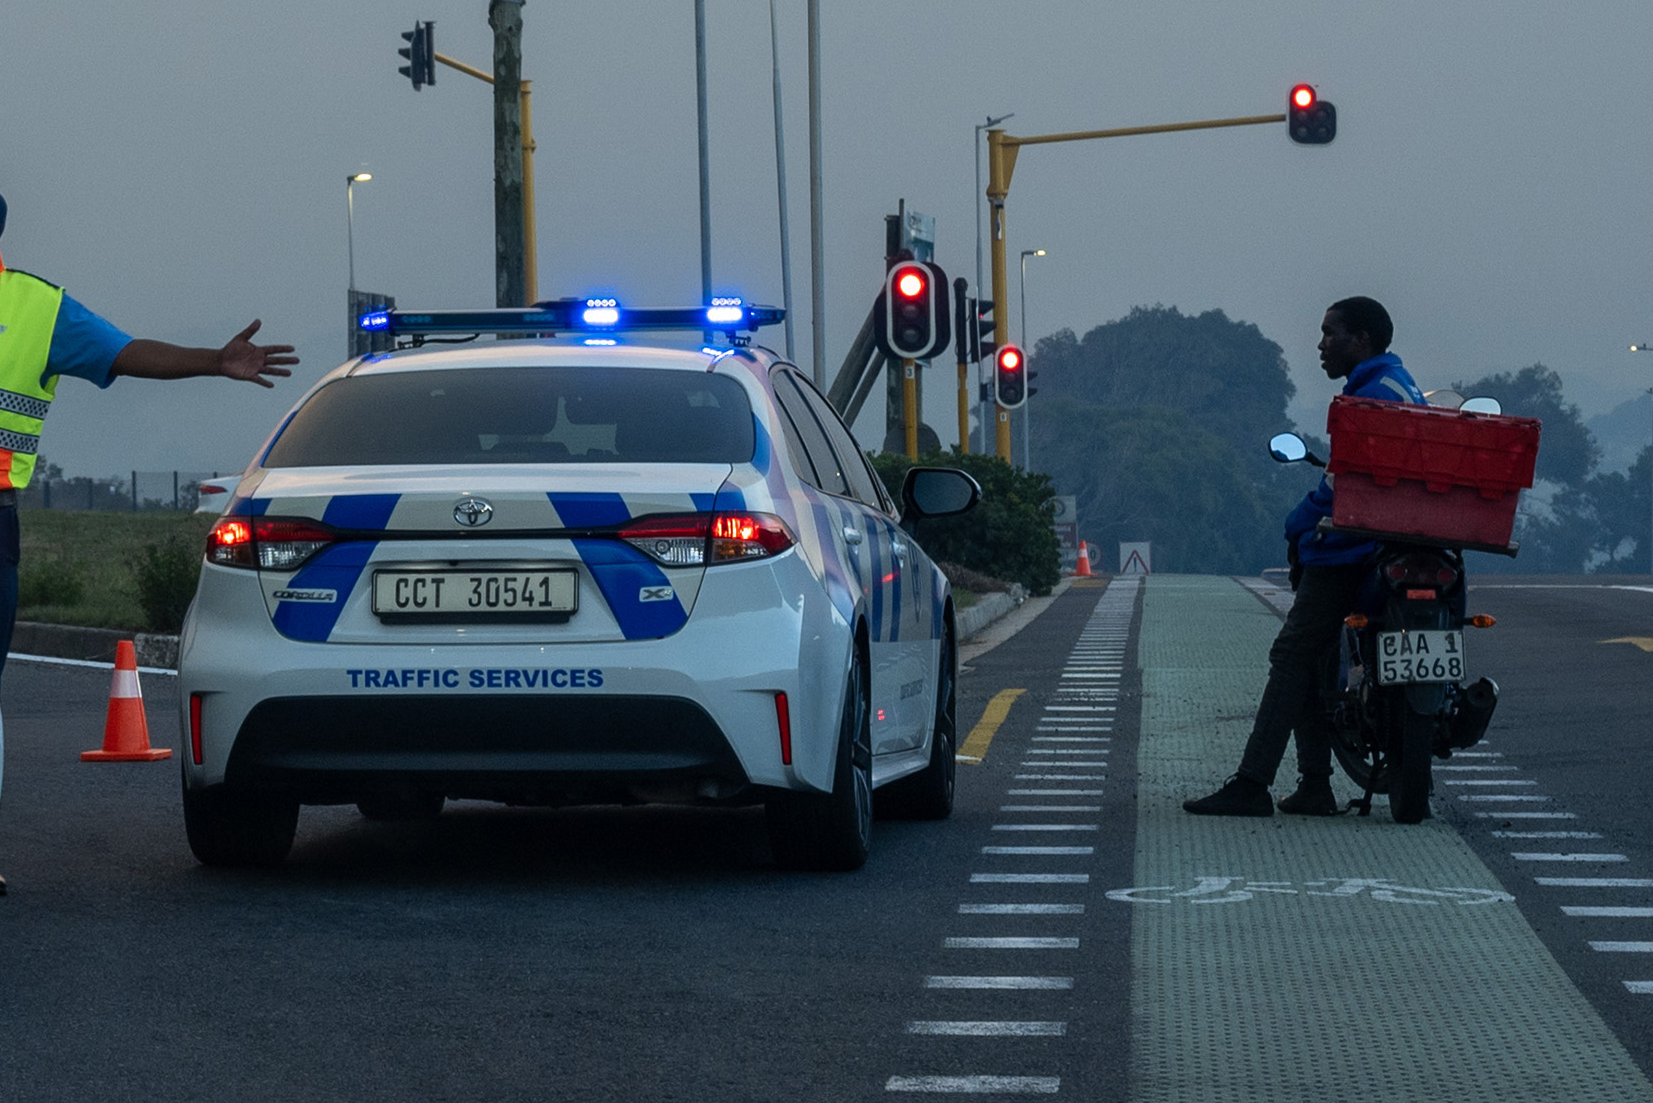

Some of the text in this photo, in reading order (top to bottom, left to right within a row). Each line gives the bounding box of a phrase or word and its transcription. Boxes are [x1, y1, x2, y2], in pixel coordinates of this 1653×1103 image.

[395, 576, 552, 608] CCT 30541
[1444, 632, 1459, 654] 1
[346, 669, 604, 688] TRAFFIC SERVICES
[1383, 656, 1462, 682] 53668
